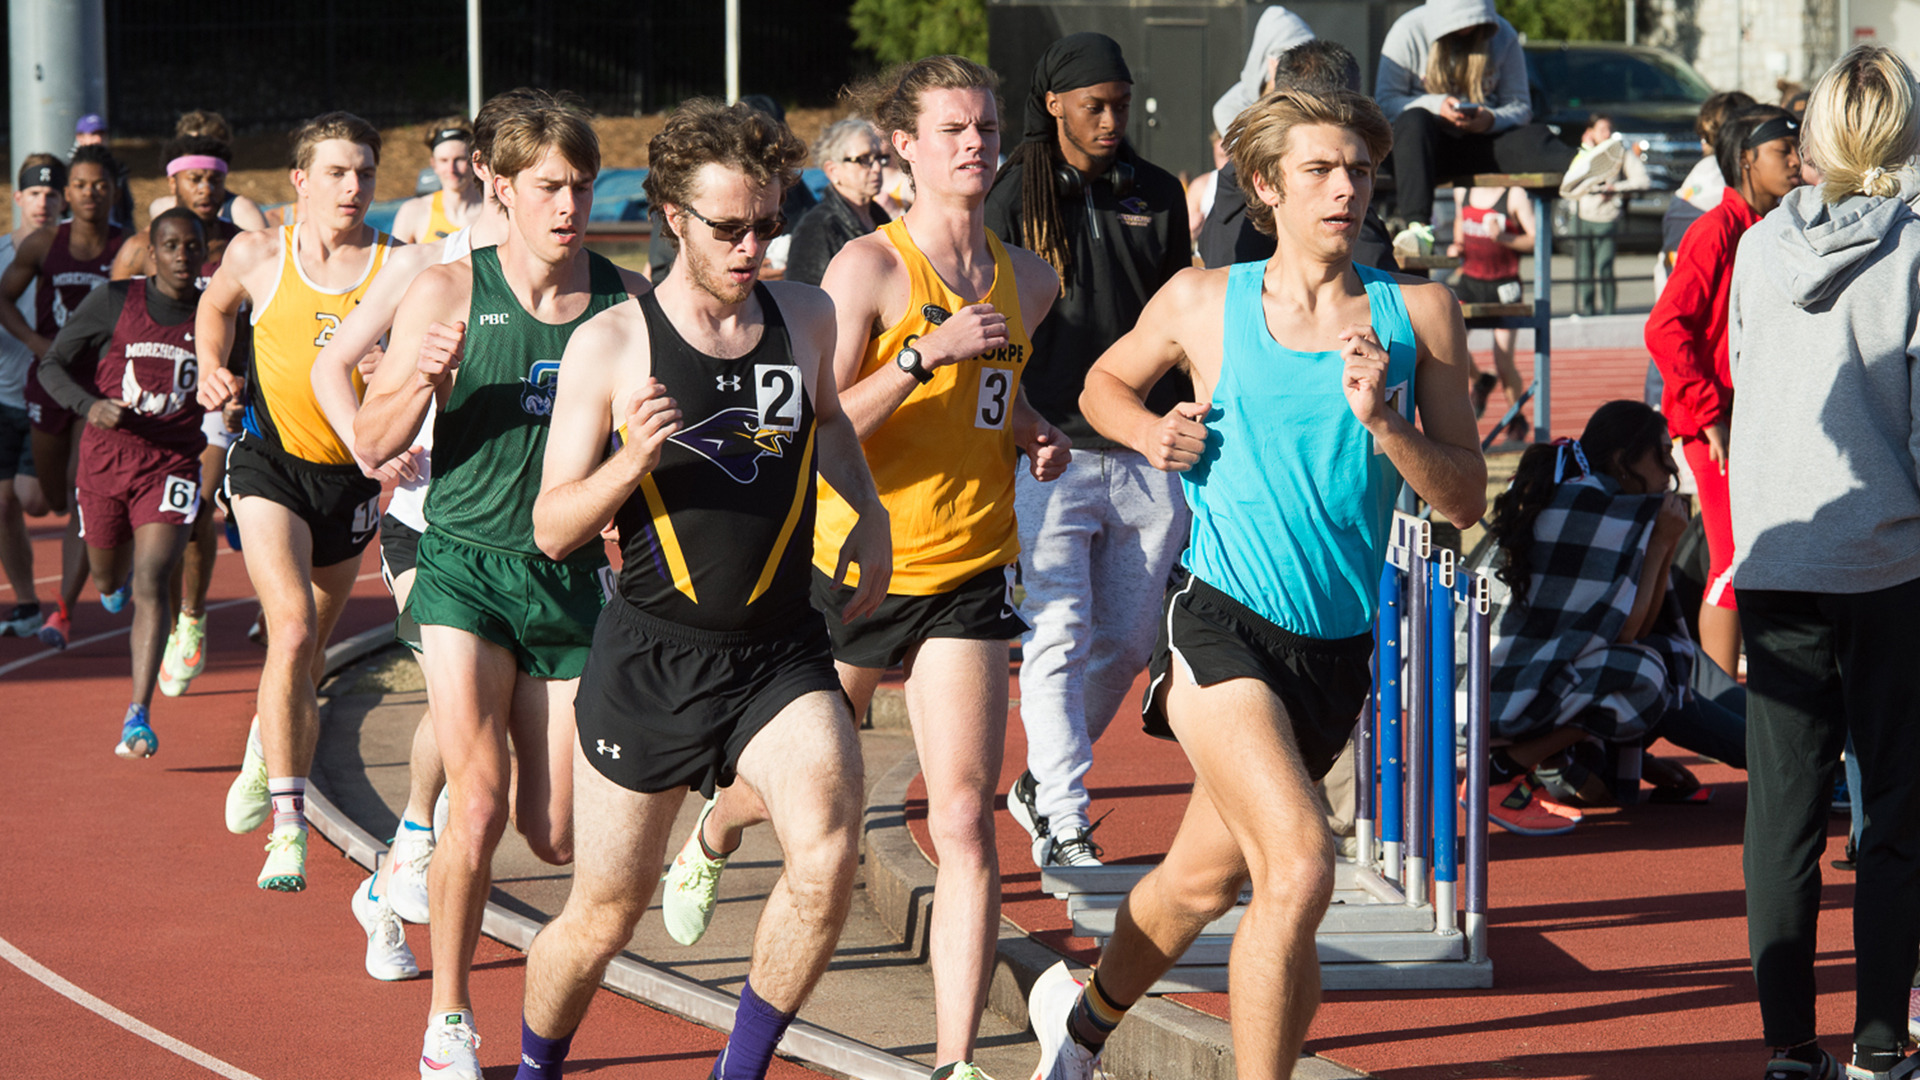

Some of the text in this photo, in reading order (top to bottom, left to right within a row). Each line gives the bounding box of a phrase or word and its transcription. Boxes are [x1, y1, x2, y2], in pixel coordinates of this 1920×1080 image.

[479, 313, 509, 326] PBC
[178, 358, 198, 390] 6
[761, 368, 795, 427] 2
[981, 372, 1008, 426] 3
[169, 481, 189, 509] 6
